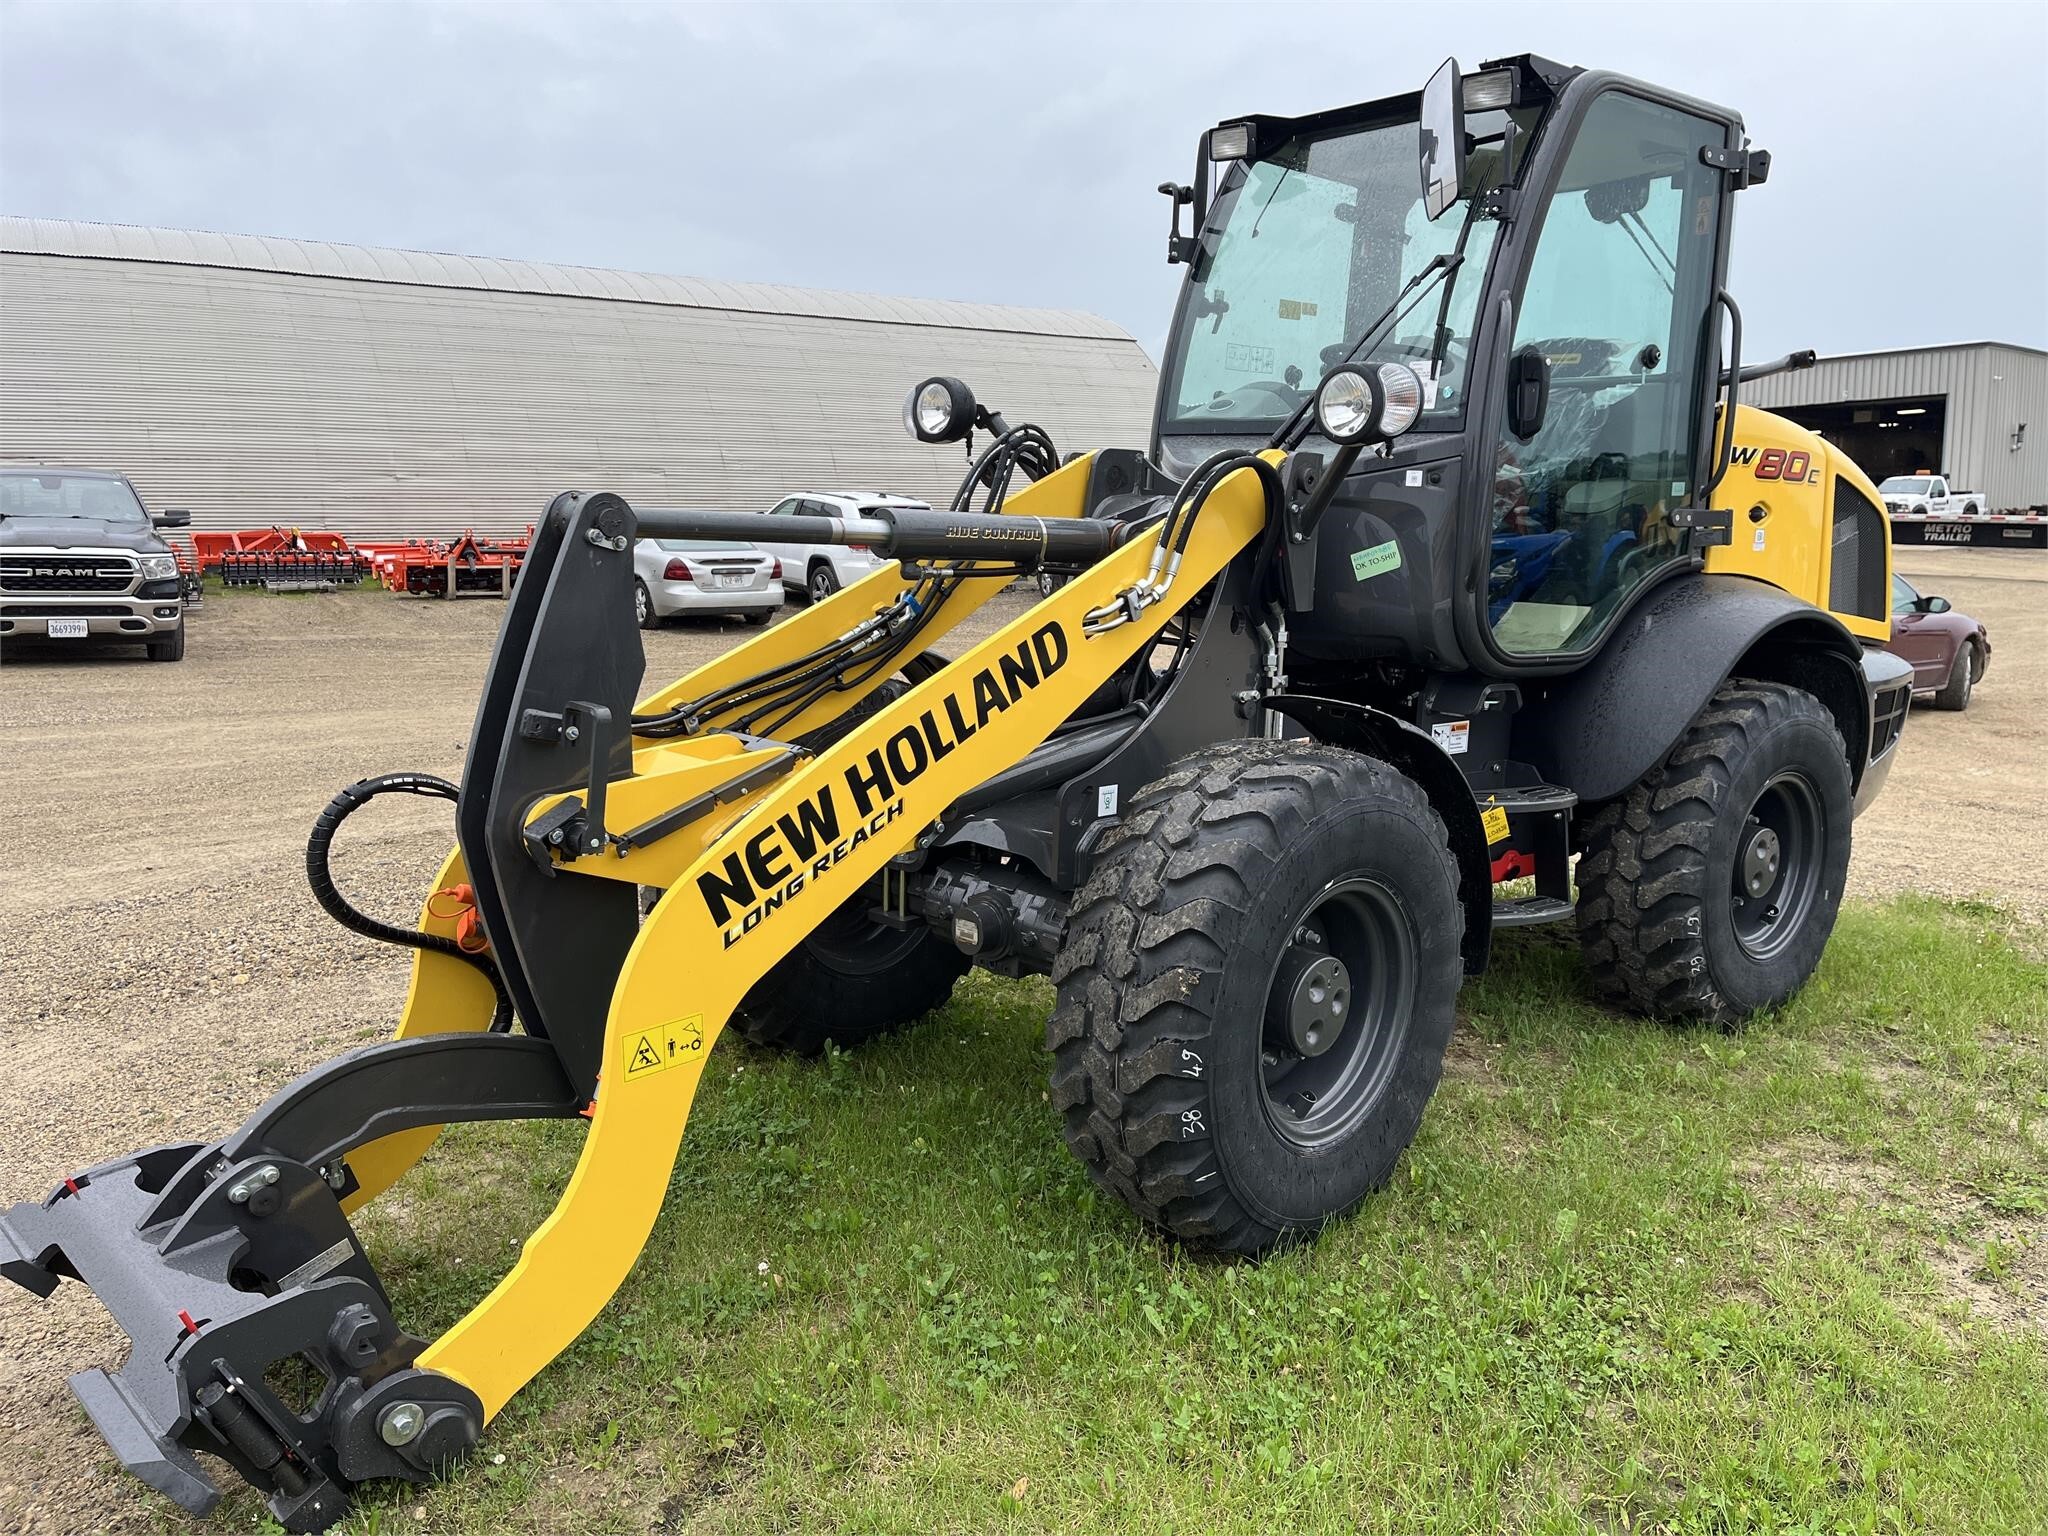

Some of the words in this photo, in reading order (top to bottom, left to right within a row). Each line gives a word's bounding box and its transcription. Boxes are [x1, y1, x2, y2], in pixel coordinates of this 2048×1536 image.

[945, 526, 980, 538] RIDE
[982, 527, 1042, 541] CONTROL
[1924, 523, 1972, 533] METRO
[1924, 533, 1972, 542] TRAILER
[35, 568, 94, 577] RAM
[696, 784, 841, 928] NEW
[843, 620, 1069, 819] HOLLAND
[723, 872, 806, 951] LONG
[812, 797, 905, 883] REACH
[1181, 1048, 1203, 1077] 49
[1181, 1109, 1206, 1138] 38
